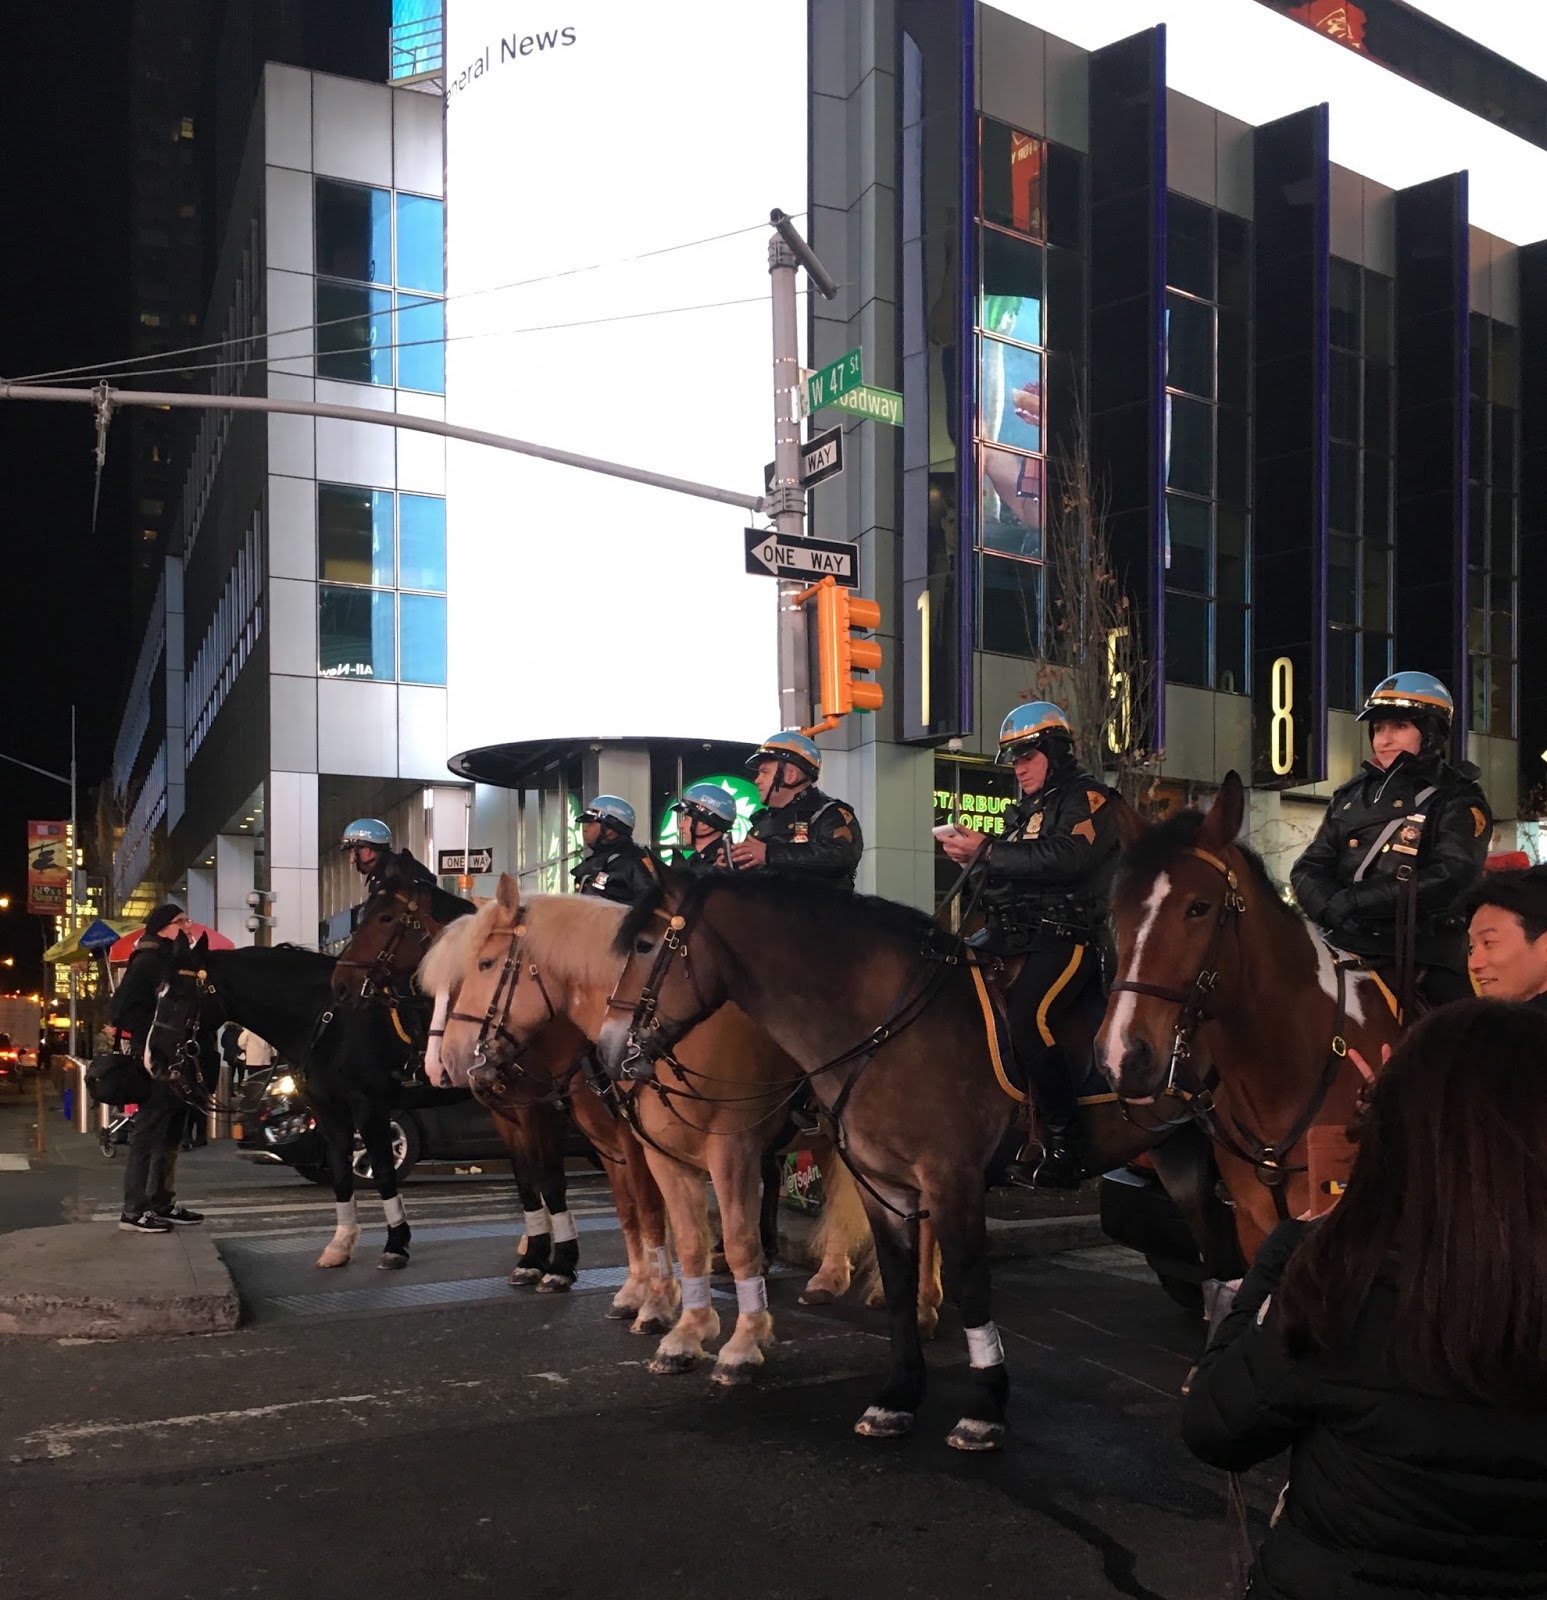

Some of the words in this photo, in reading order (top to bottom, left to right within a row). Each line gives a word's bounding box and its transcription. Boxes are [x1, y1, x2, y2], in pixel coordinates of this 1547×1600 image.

[446, 46, 489, 110] eneral
[501, 26, 577, 64] News
[812, 376, 824, 406] W
[829, 363, 845, 395] 47
[839, 387, 898, 425] oadway
[807, 445, 832, 472] WAY
[763, 545, 795, 566] ONE
[811, 552, 843, 573] WAY
[917, 589, 930, 726] 1
[1271, 656, 1294, 776] 8
[933, 790, 1017, 815] STARBUC
[947, 813, 1005, 835] OFFE
[447, 857, 465, 868] ONE
[472, 855, 489, 868] WAY
